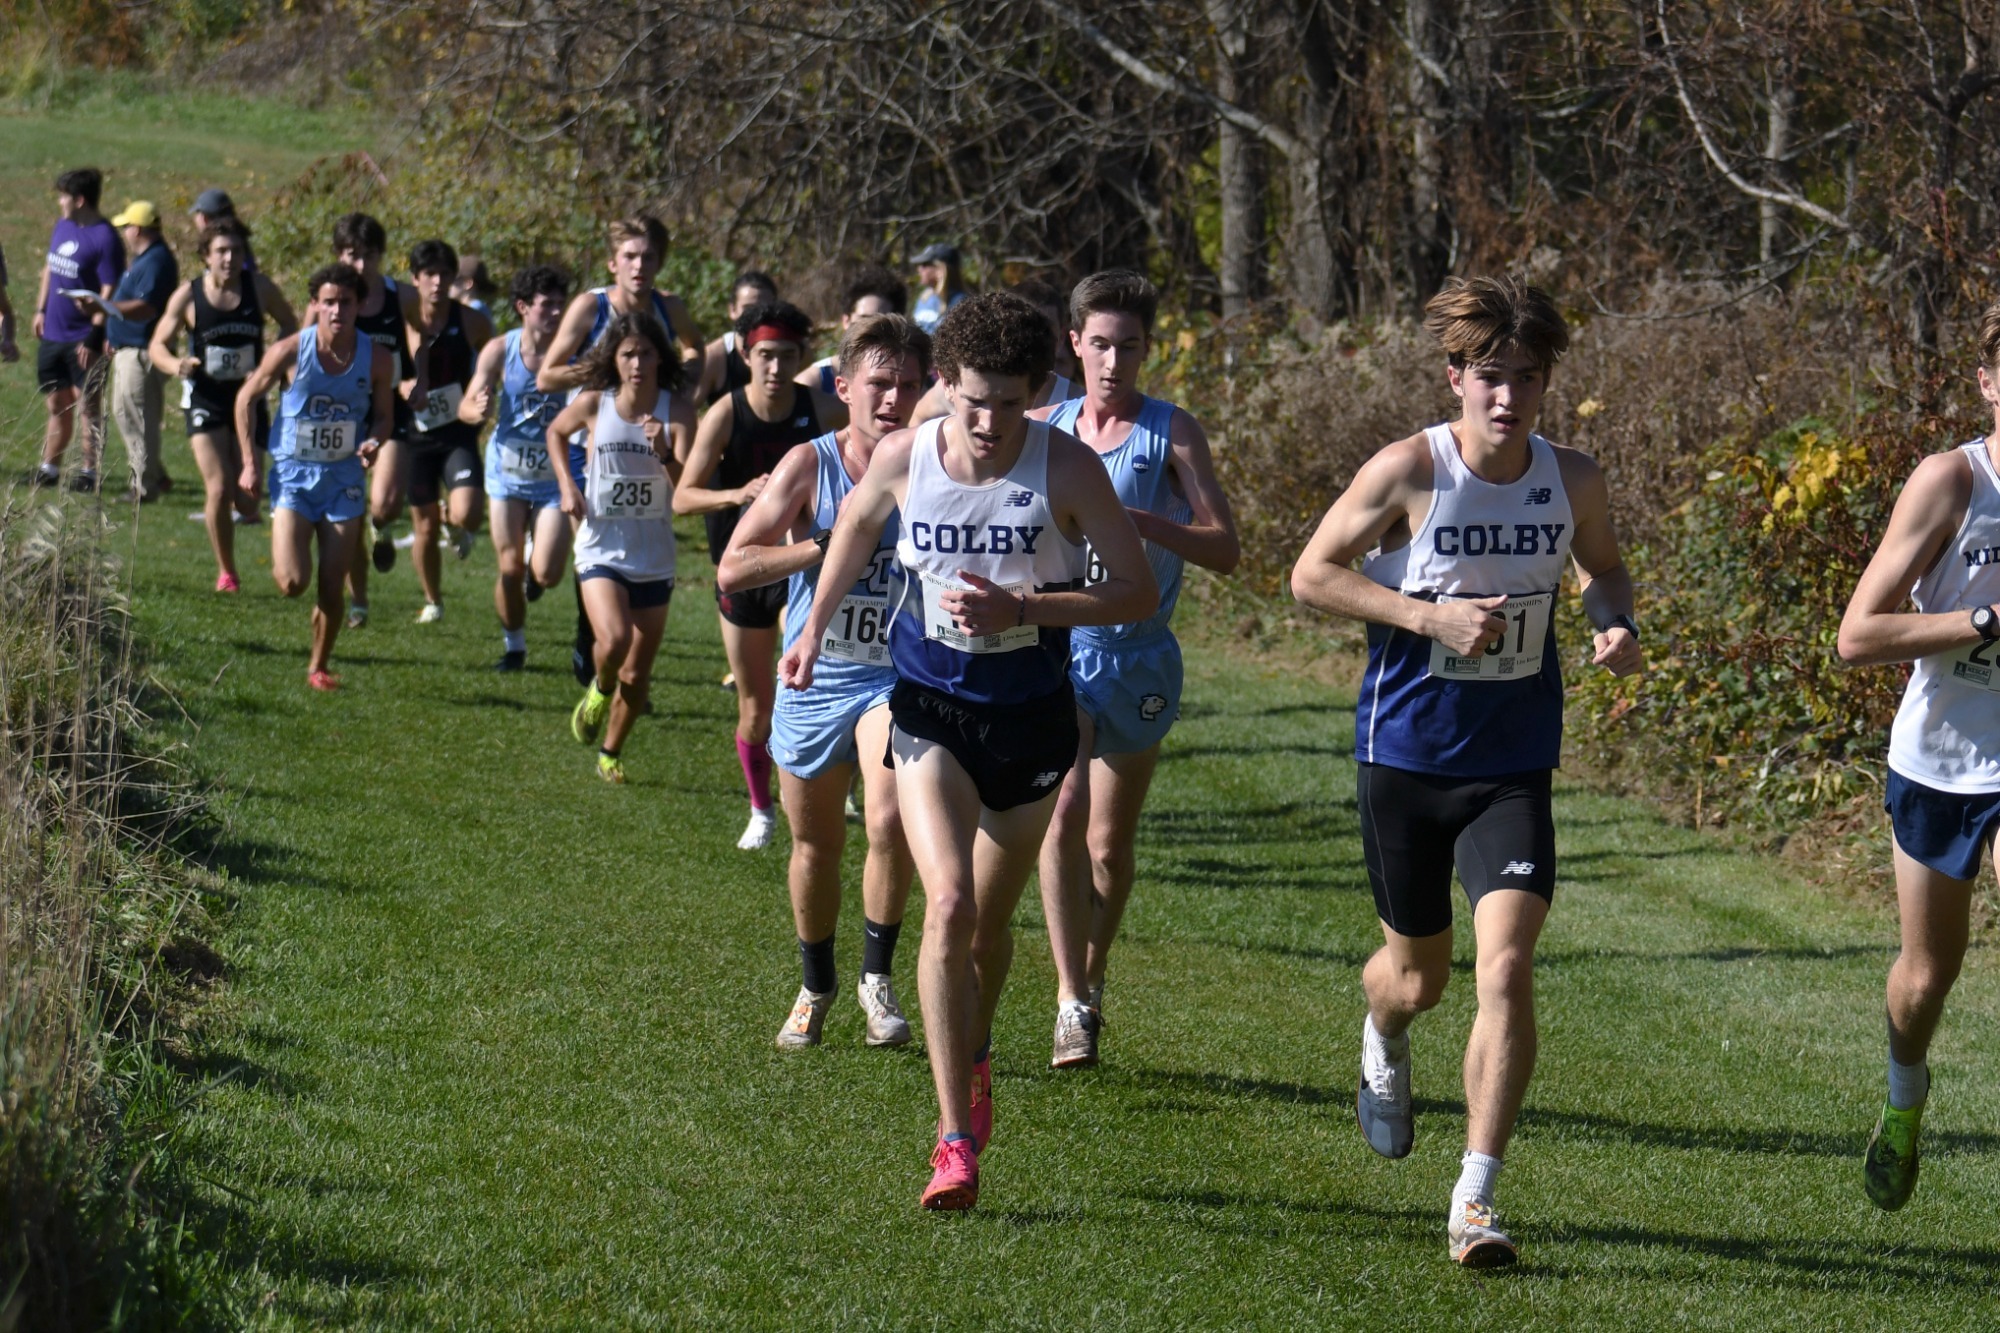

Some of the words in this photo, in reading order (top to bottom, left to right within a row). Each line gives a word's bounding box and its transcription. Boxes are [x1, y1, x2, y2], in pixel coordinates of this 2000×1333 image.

[221, 352, 241, 370] 92
[428, 393, 450, 417] 65
[310, 427, 344, 450] 156
[517, 446, 549, 471] 152
[612, 482, 652, 507] 235
[911, 521, 1044, 555] COLBY
[1433, 523, 1566, 557] COLBY
[926, 574, 955, 592] NESCAC
